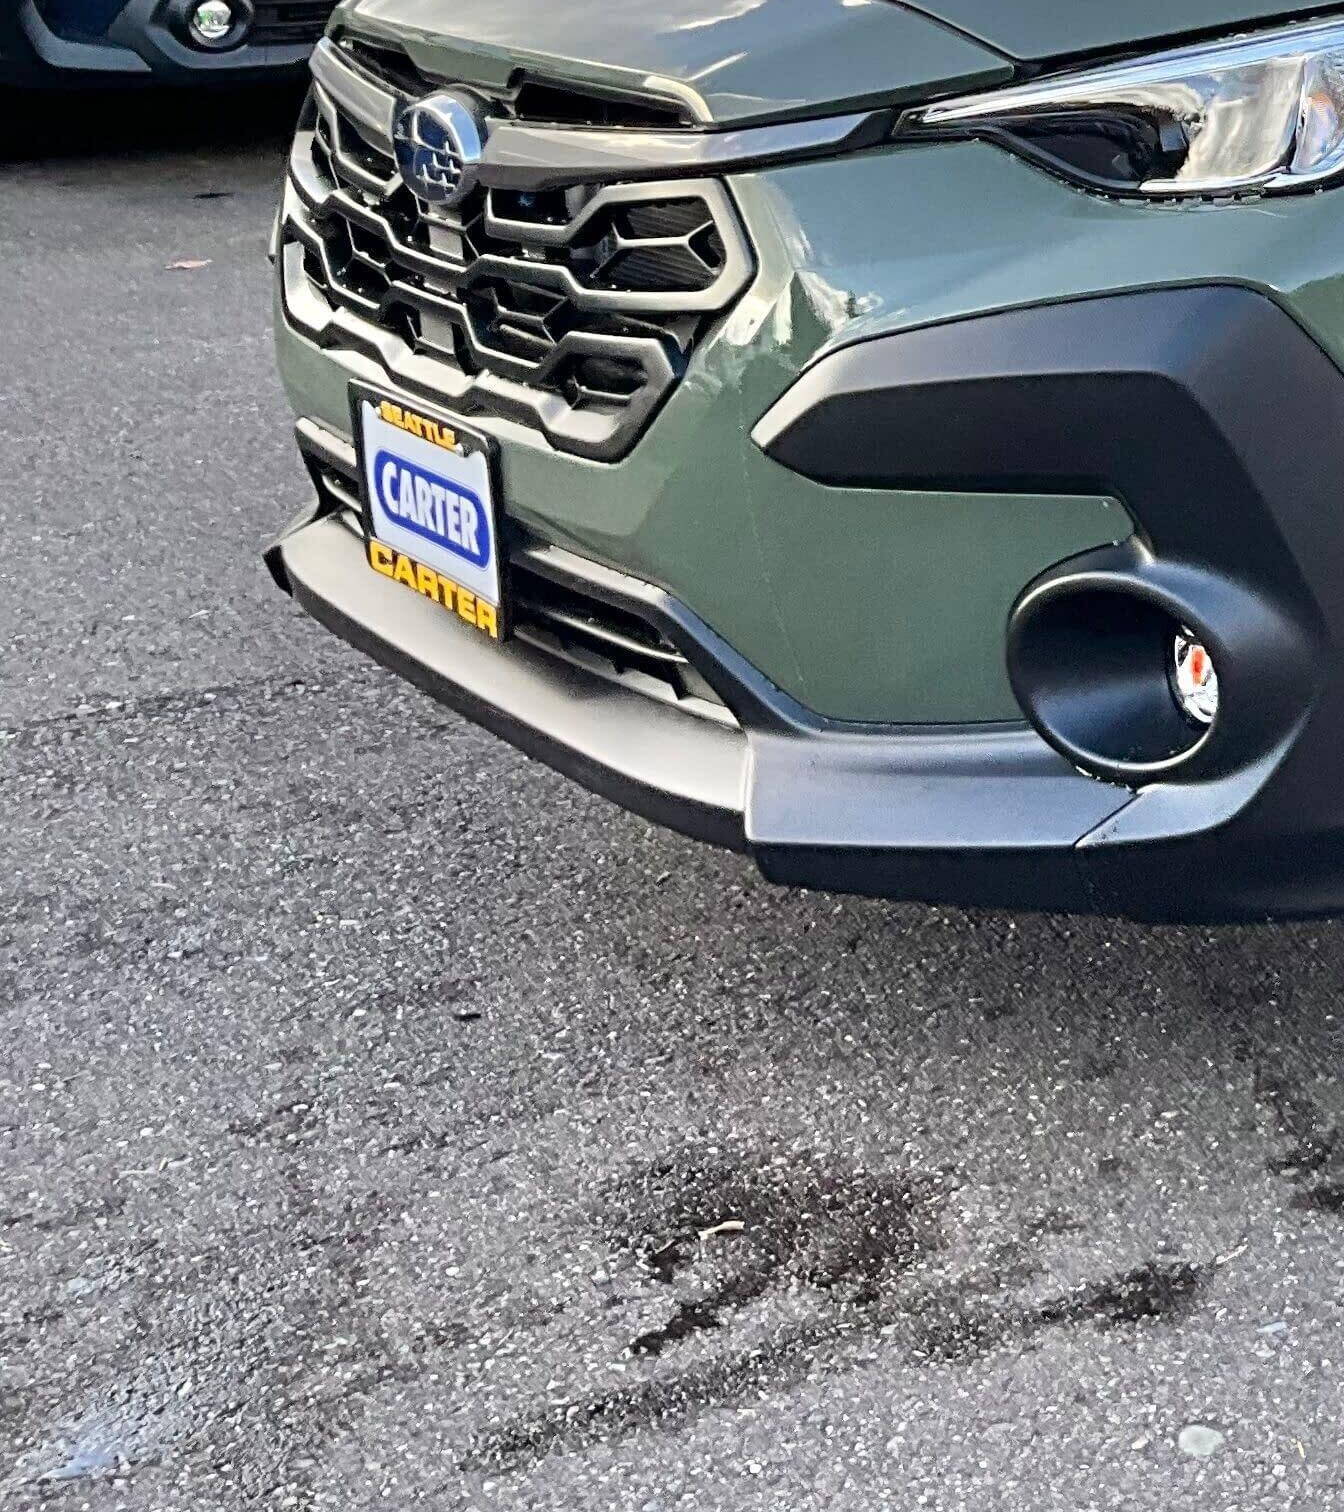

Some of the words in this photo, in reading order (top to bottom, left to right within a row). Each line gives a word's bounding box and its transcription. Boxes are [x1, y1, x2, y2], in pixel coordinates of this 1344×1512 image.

[379, 400, 458, 452] SEATTLE
[381, 460, 482, 557] CARTER
[370, 541, 498, 638] CARTER
